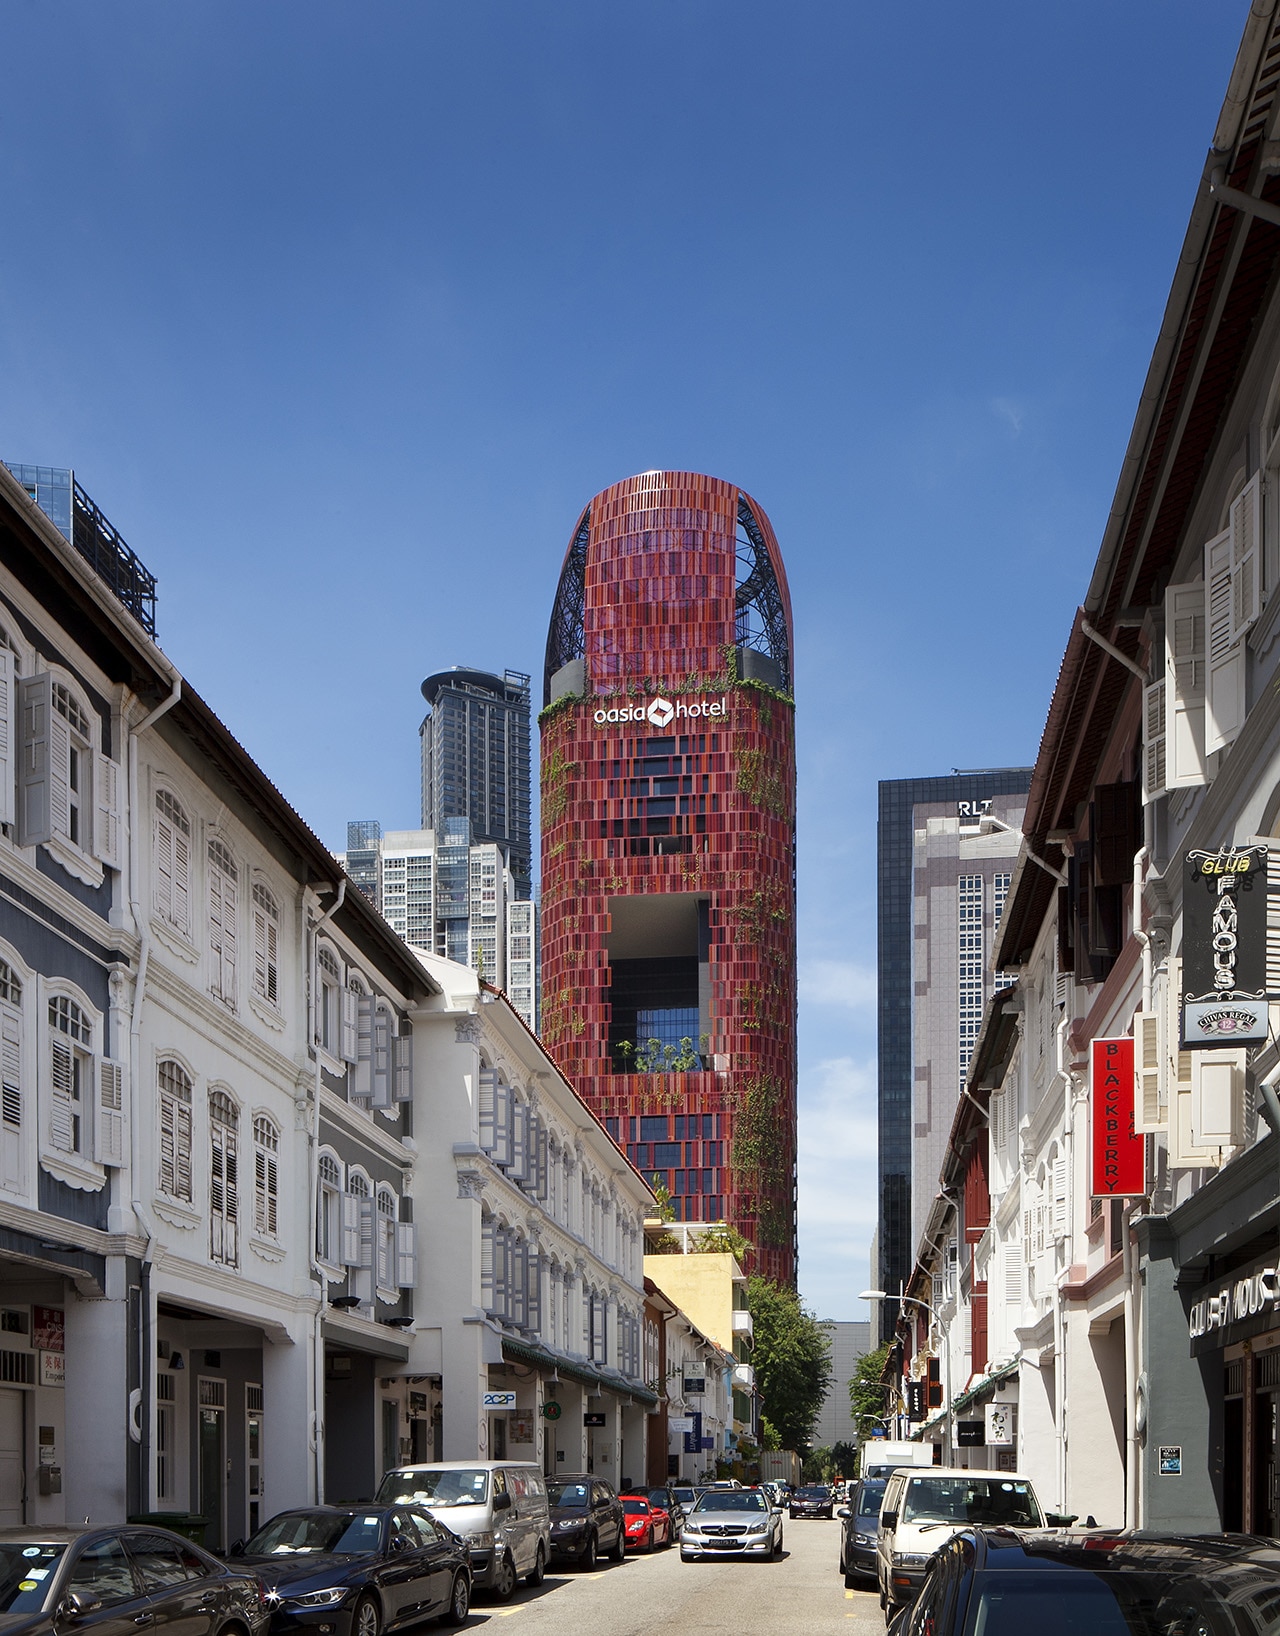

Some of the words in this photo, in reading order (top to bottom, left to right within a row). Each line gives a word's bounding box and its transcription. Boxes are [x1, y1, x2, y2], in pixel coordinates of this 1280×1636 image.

[594, 703, 646, 723] oasia
[676, 697, 726, 718] hotel
[1201, 855, 1251, 874] CLUB
[1212, 875, 1238, 990] FAMOUS
[1199, 1012, 1228, 1026] CHIVAS
[1229, 1011, 1255, 1024] REGAL
[1222, 1019, 1232, 1029] 12
[1104, 1043, 1120, 1192] BLACKBERRY
[484, 1394, 515, 1405] 2C2P
